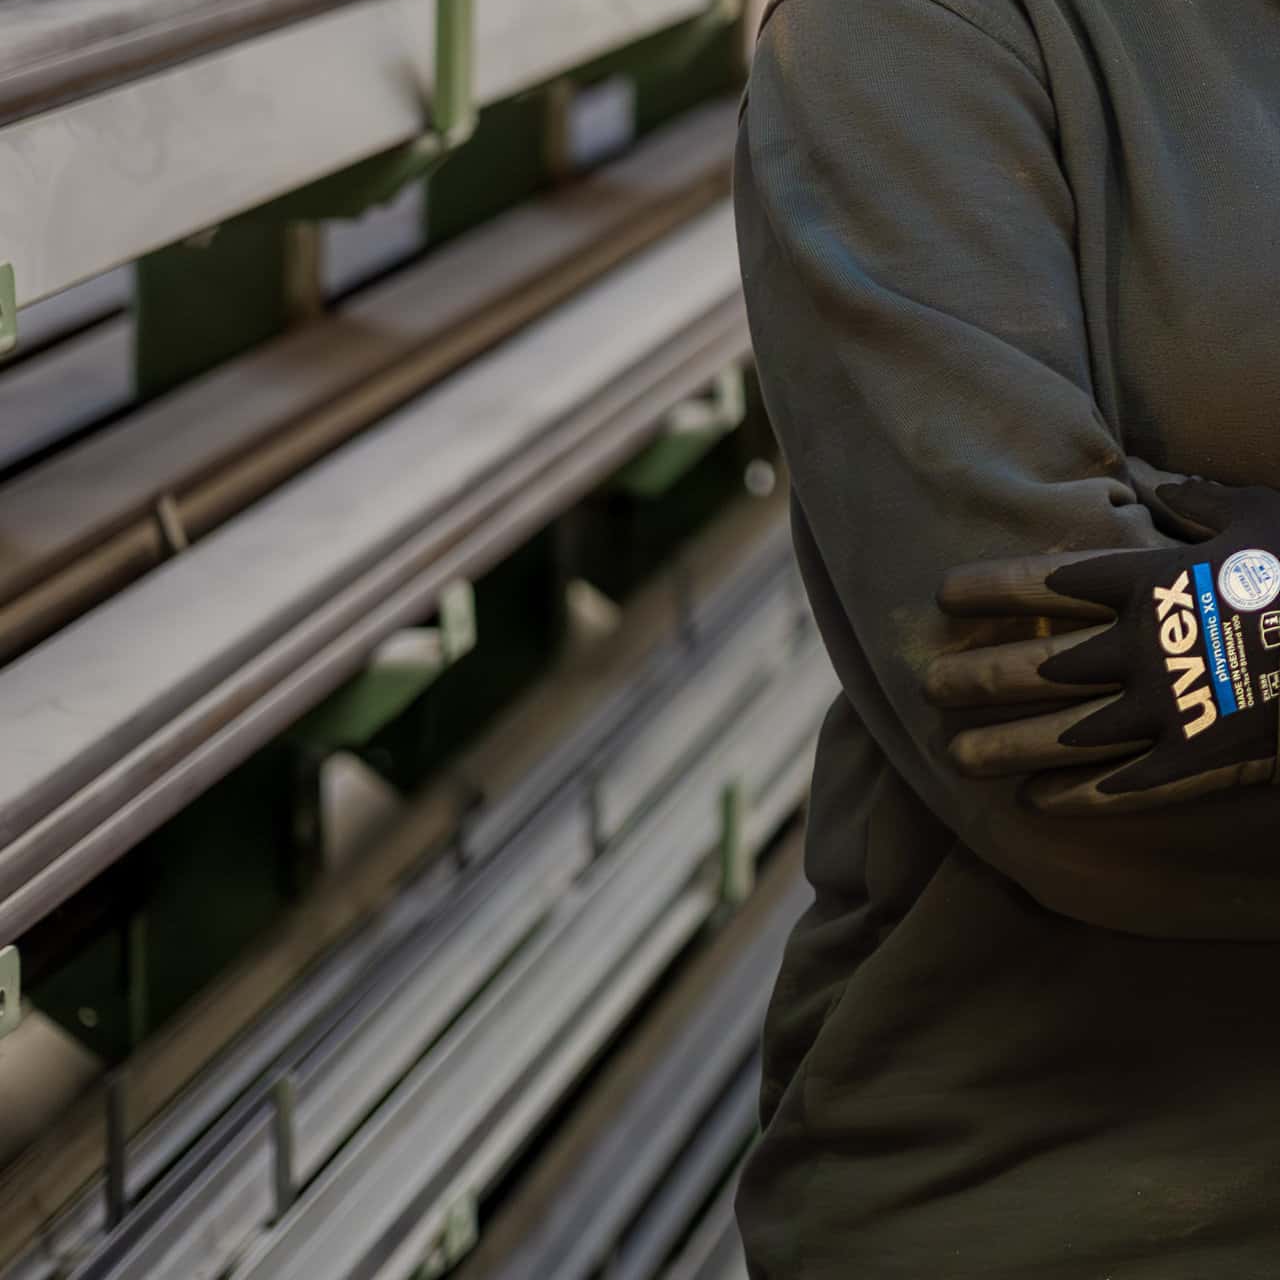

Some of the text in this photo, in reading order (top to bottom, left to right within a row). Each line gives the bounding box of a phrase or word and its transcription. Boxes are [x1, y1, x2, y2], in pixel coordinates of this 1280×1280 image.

[1153, 570, 1218, 739] uvex
[1201, 592, 1230, 683] phynomic XG
[1223, 622, 1247, 710] MADE IN GERMANY
